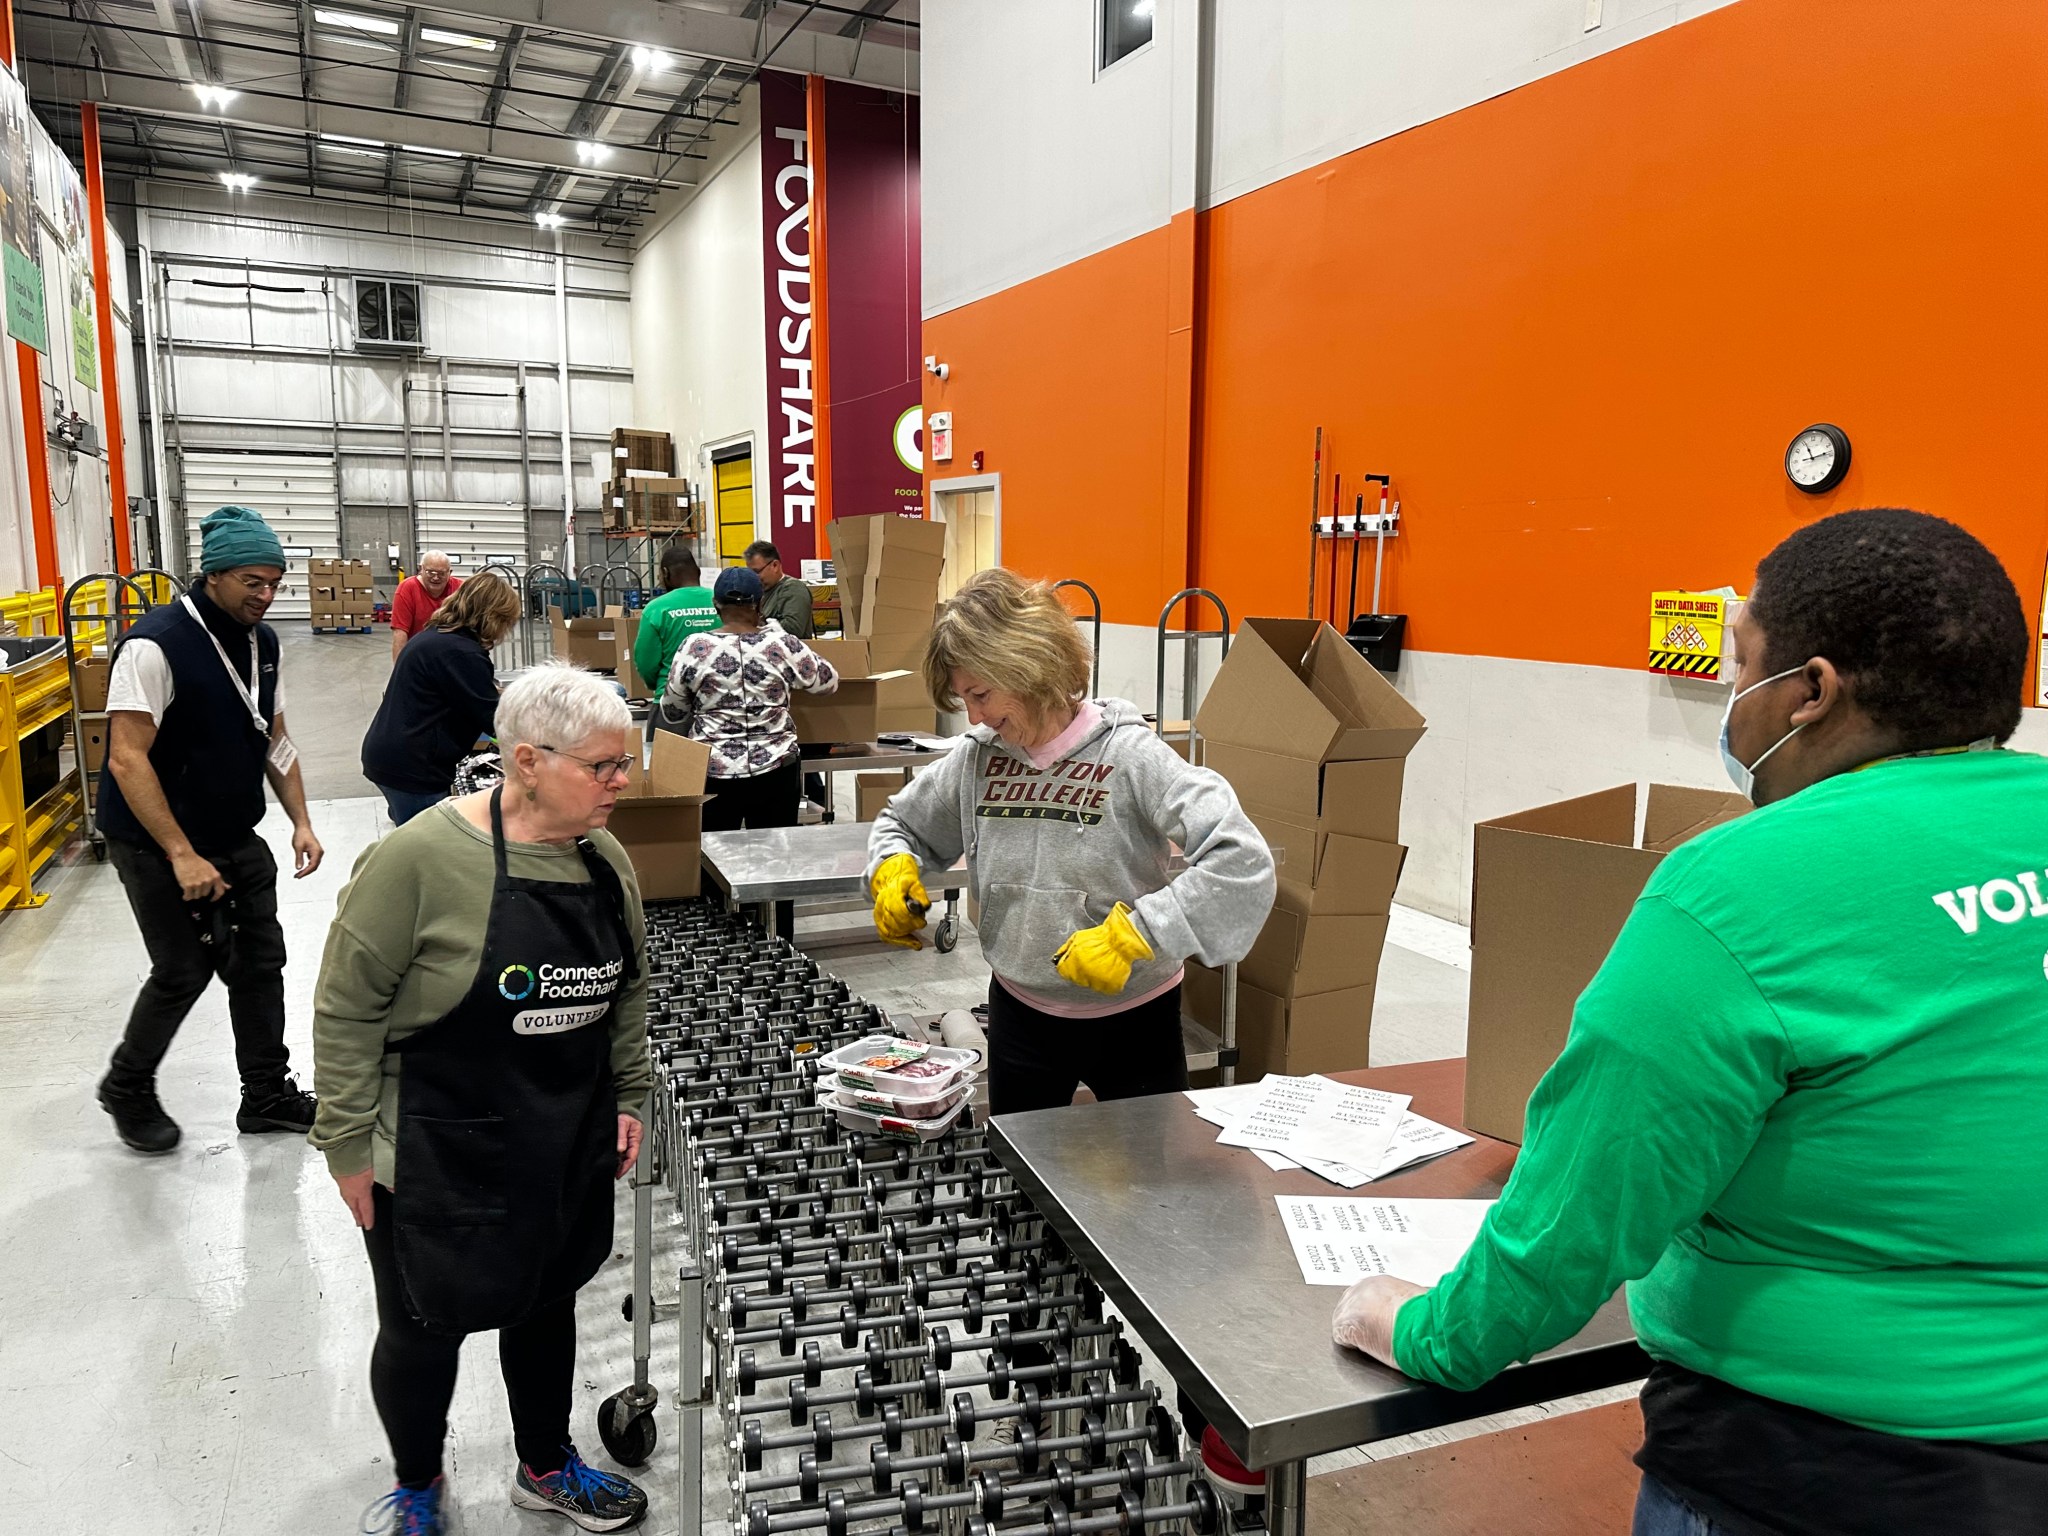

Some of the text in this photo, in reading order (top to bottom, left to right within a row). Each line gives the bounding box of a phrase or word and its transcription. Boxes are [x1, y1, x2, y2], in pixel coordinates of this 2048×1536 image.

[895, 489, 918, 497] FOOD
[1655, 599, 1718, 613] SAFETY DATA SHEETS
[983, 781, 1111, 809] COLLEGE
[983, 808, 1092, 823] EAGLES
[1931, 868, 2048, 934] VOL
[540, 979, 618, 999] Foodshare
[1256, 1111, 1298, 1121] 8150022
[1246, 1125, 1290, 1135] 8150022
[1306, 1204, 1317, 1216] Lamb
[1348, 1204, 1359, 1217] Lamb
[1388, 1204, 1400, 1218] Lamb
[1313, 1221, 1323, 1230] Pork
[1356, 1221, 1367, 1232] Pork
[1396, 1222, 1408, 1232] Pork
[1323, 1244, 1334, 1256] Lamb
[1367, 1245, 1378, 1257] Lamb
[1330, 1261, 1341, 1272] Pork
[1375, 1262, 1386, 1273] Pork
